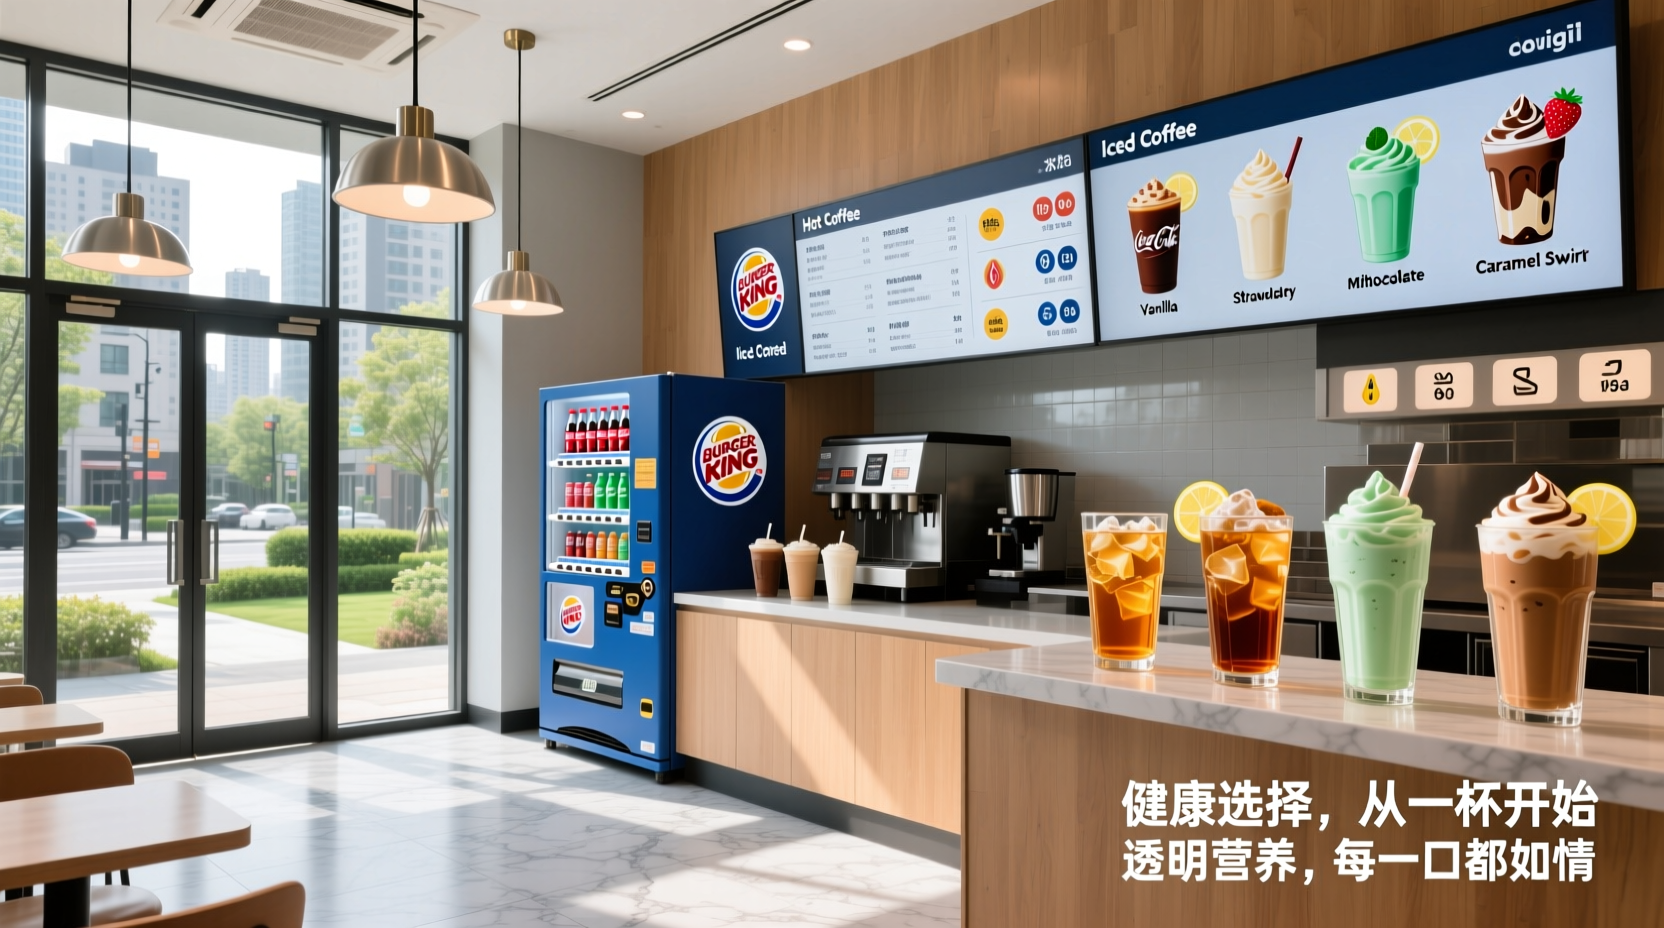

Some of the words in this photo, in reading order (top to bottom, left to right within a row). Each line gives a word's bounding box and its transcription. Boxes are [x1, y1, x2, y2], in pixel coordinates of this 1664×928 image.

[1102, 132, 1136, 158] Iced
[1140, 121, 1197, 148] Coffee
[802, 215, 822, 233] Hot
[824, 207, 861, 226] Coffee
[1475, 251, 1541, 274] Caramel
[740, 275, 777, 312] KING
[703, 434, 756, 463] BURGER
[705, 447, 758, 485] KING
